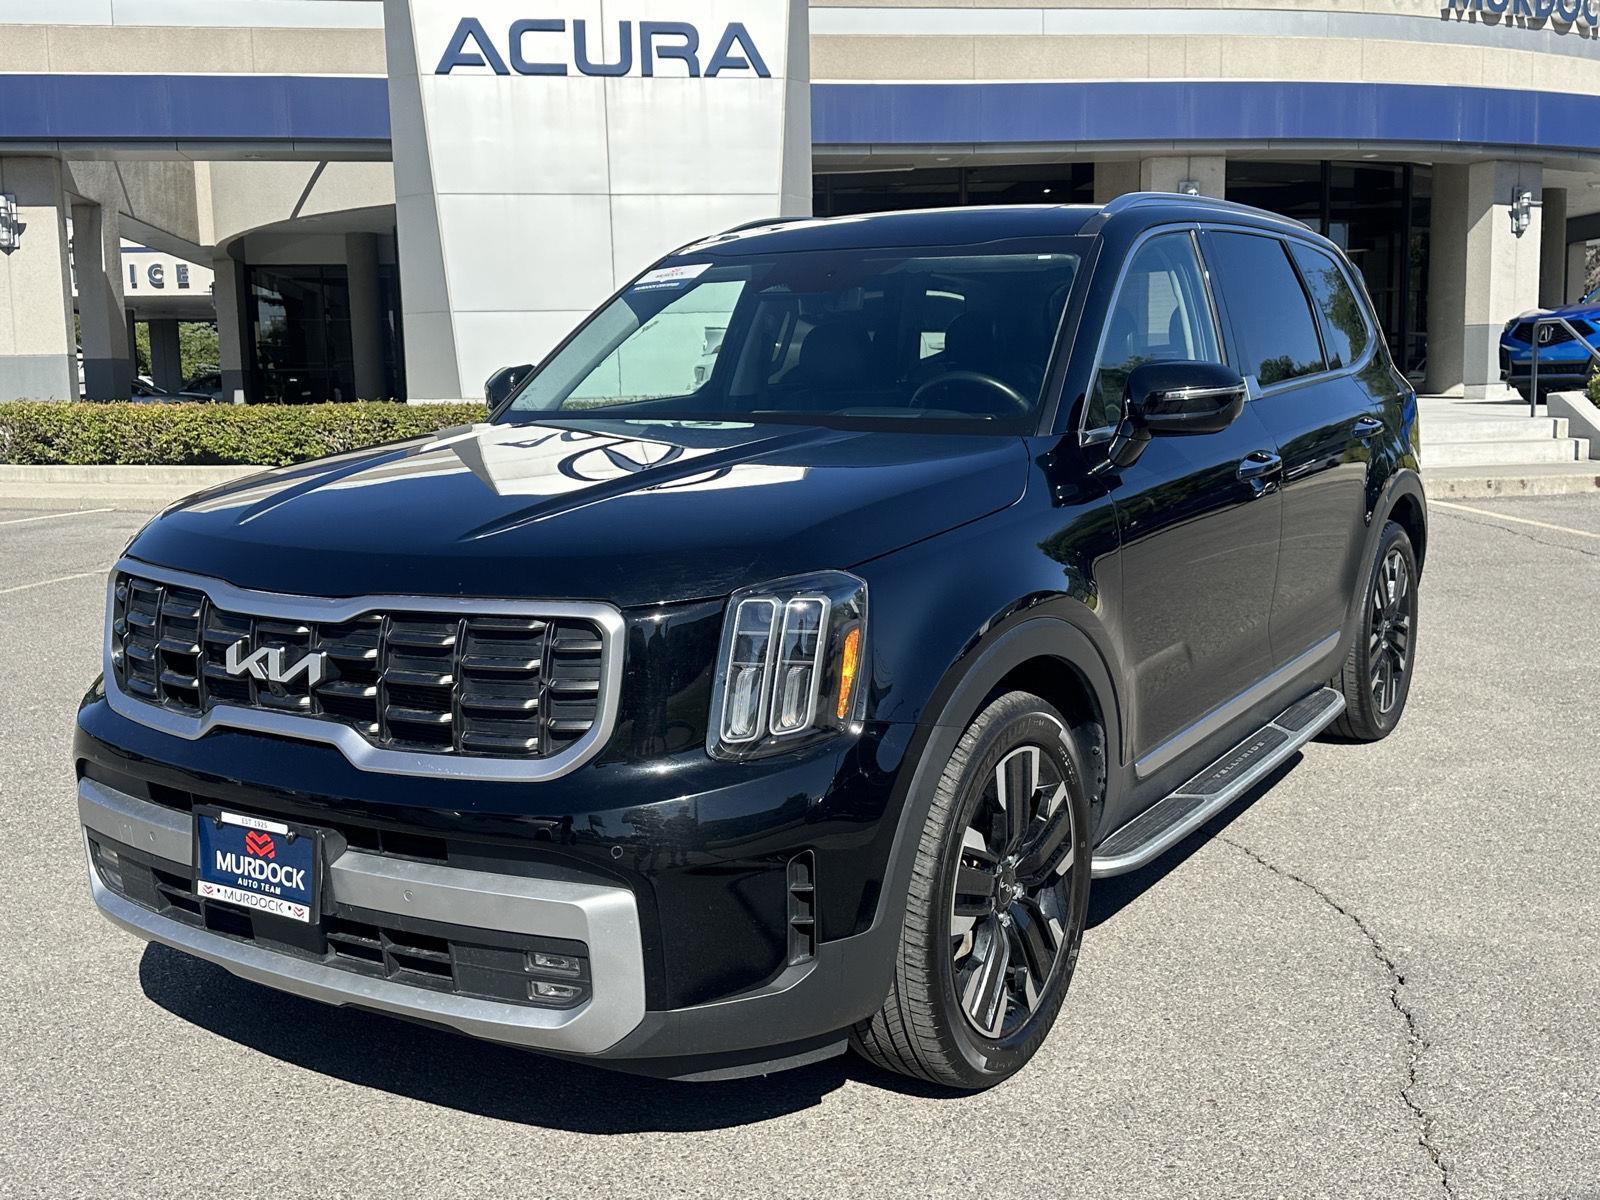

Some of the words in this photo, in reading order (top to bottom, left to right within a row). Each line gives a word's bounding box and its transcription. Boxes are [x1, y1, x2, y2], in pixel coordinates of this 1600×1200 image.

[434, 17, 772, 78] ACURA
[225, 640, 327, 687] KIA
[1212, 740, 1266, 780] TELLURIDE
[216, 850, 306, 891] MURDOCK
[237, 877, 258, 889] AUTO
[260, 882, 281, 895] TEAM
[223, 888, 285, 914] MURDOCK
